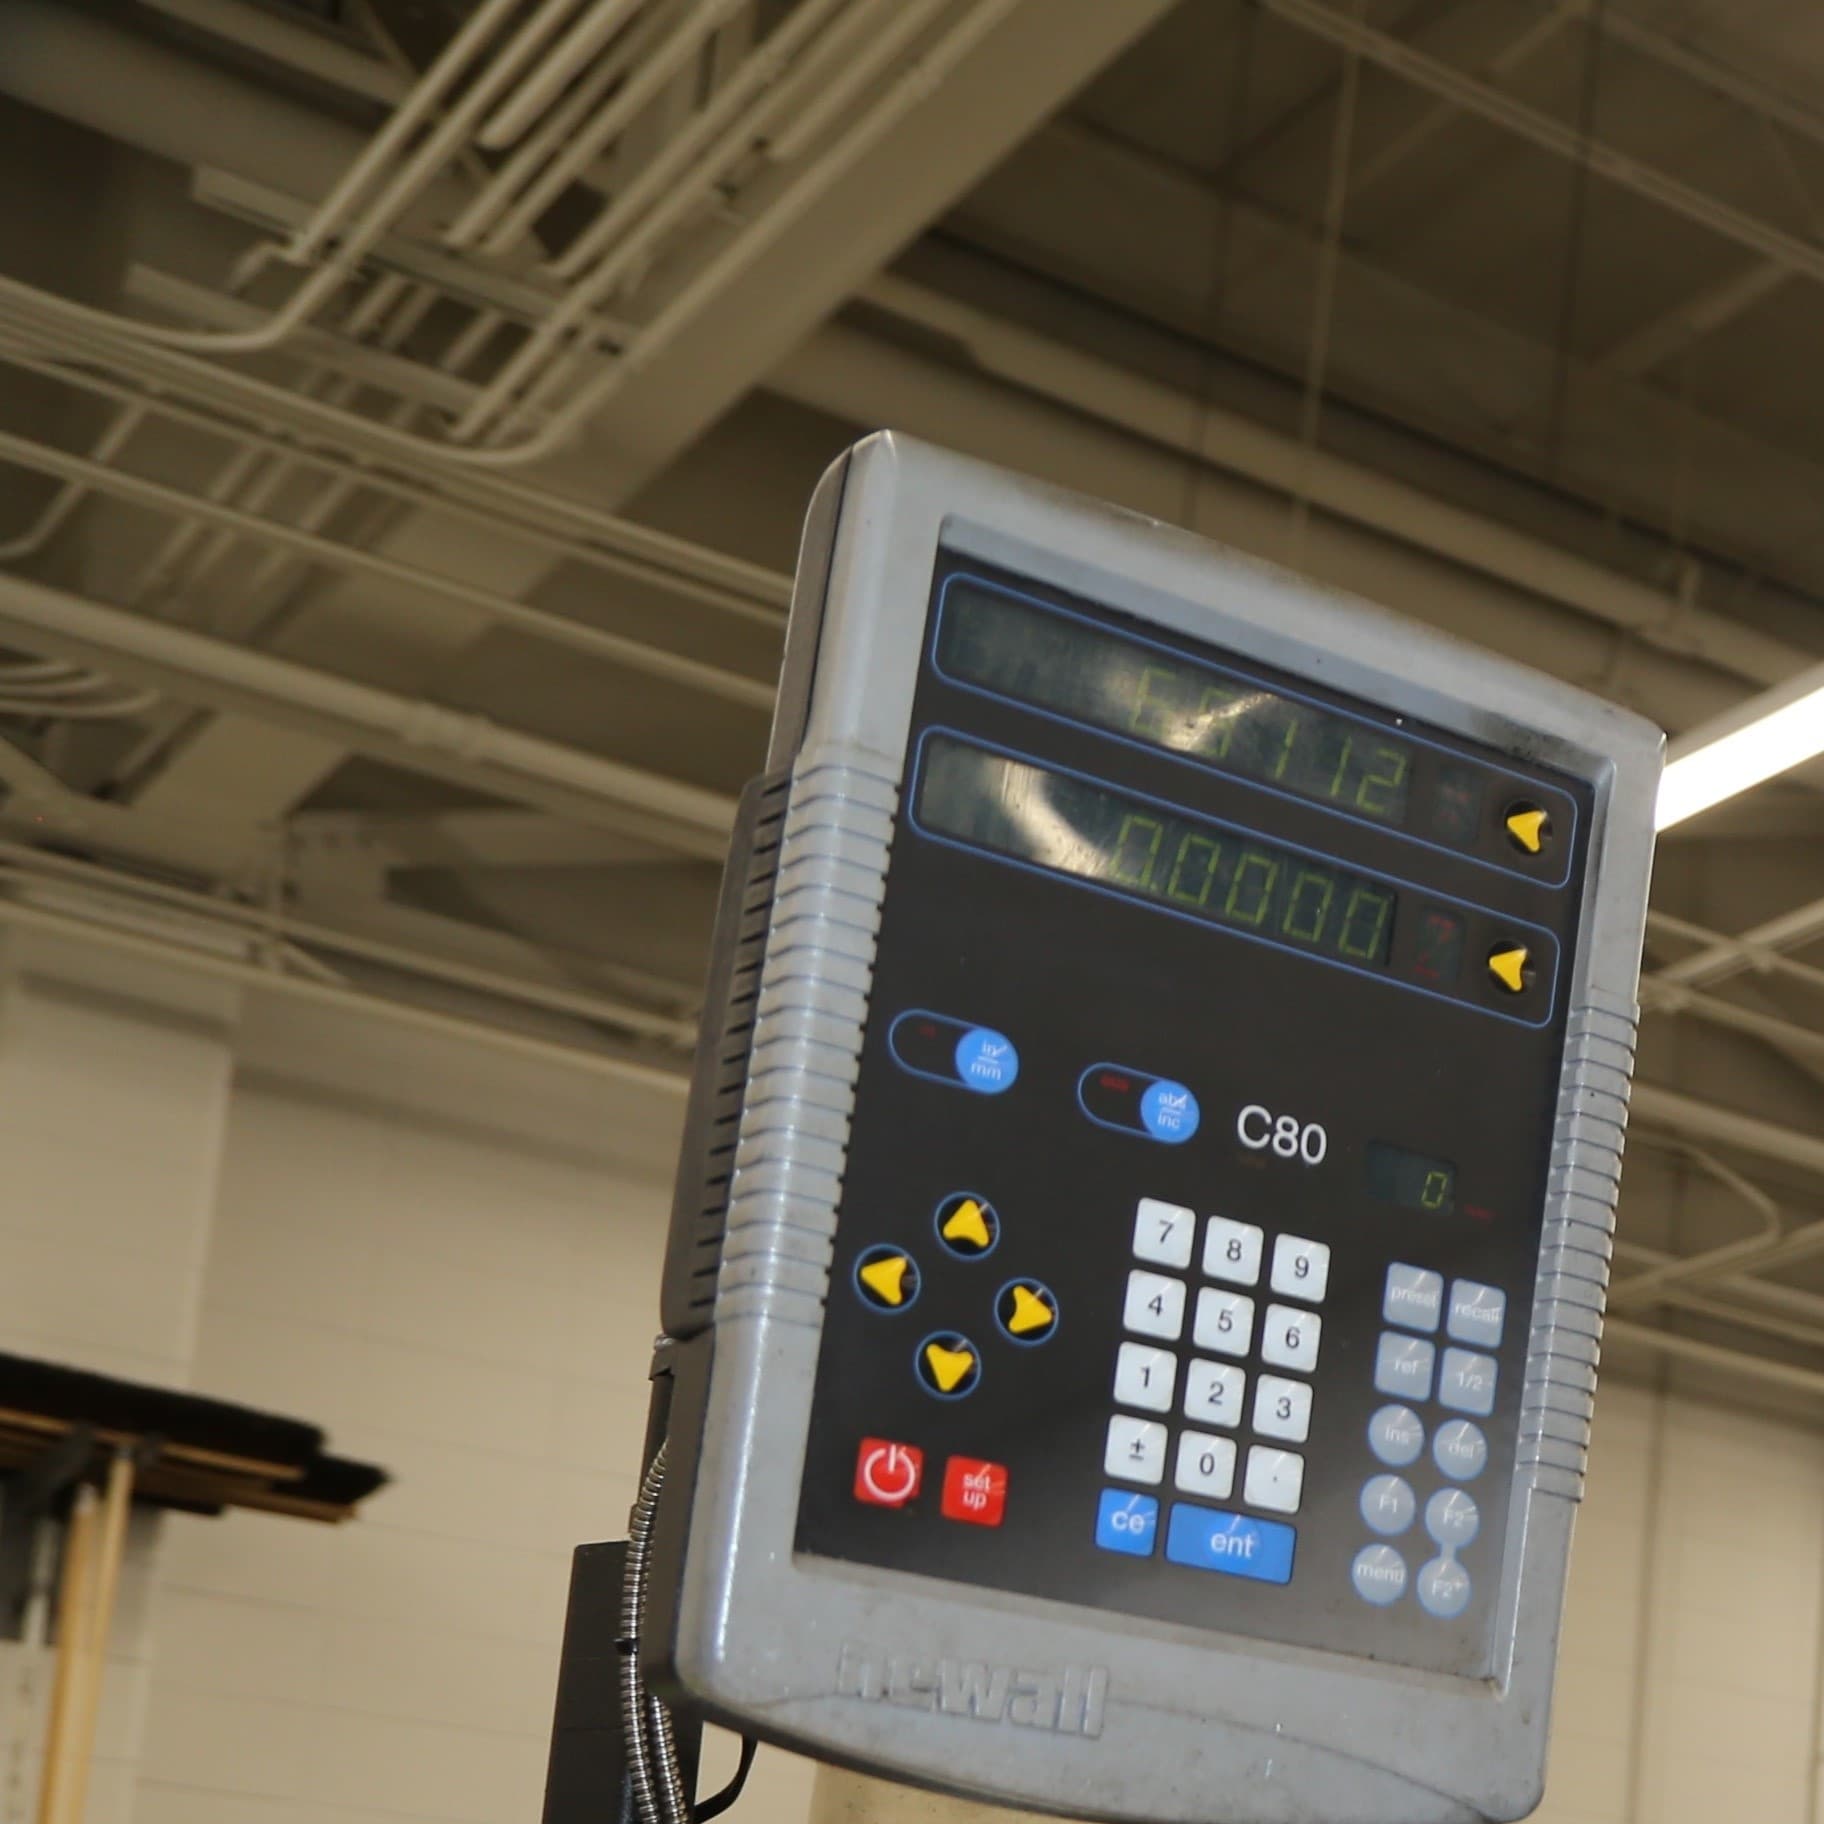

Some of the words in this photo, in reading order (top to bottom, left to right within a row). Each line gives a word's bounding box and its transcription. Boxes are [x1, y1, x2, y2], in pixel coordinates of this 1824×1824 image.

[1109, 815, 1390, 961] 0.0000
[970, 1061, 1002, 1081] mm
[1157, 1112, 1181, 1131] inc
[1236, 1104, 1328, 1165] C80
[1421, 1170, 1448, 1209] 0
[1157, 1218, 1175, 1245] 7
[1226, 1238, 1243, 1263] 8
[1293, 1255, 1310, 1280] 9
[1146, 1292, 1165, 1317] 4
[1217, 1309, 1234, 1334] 5
[1284, 1324, 1301, 1350] 6
[1139, 1365, 1151, 1389] 1
[1394, 1358, 1419, 1377] ref
[1208, 1380, 1226, 1406] 2
[1456, 1370, 1483, 1392] 1/2
[1276, 1396, 1292, 1421] 3
[1199, 1451, 1216, 1477] 0
[963, 1471, 991, 1491] set
[962, 1490, 987, 1510] up
[1110, 1510, 1146, 1535] ce
[1209, 1529, 1255, 1559] ent
